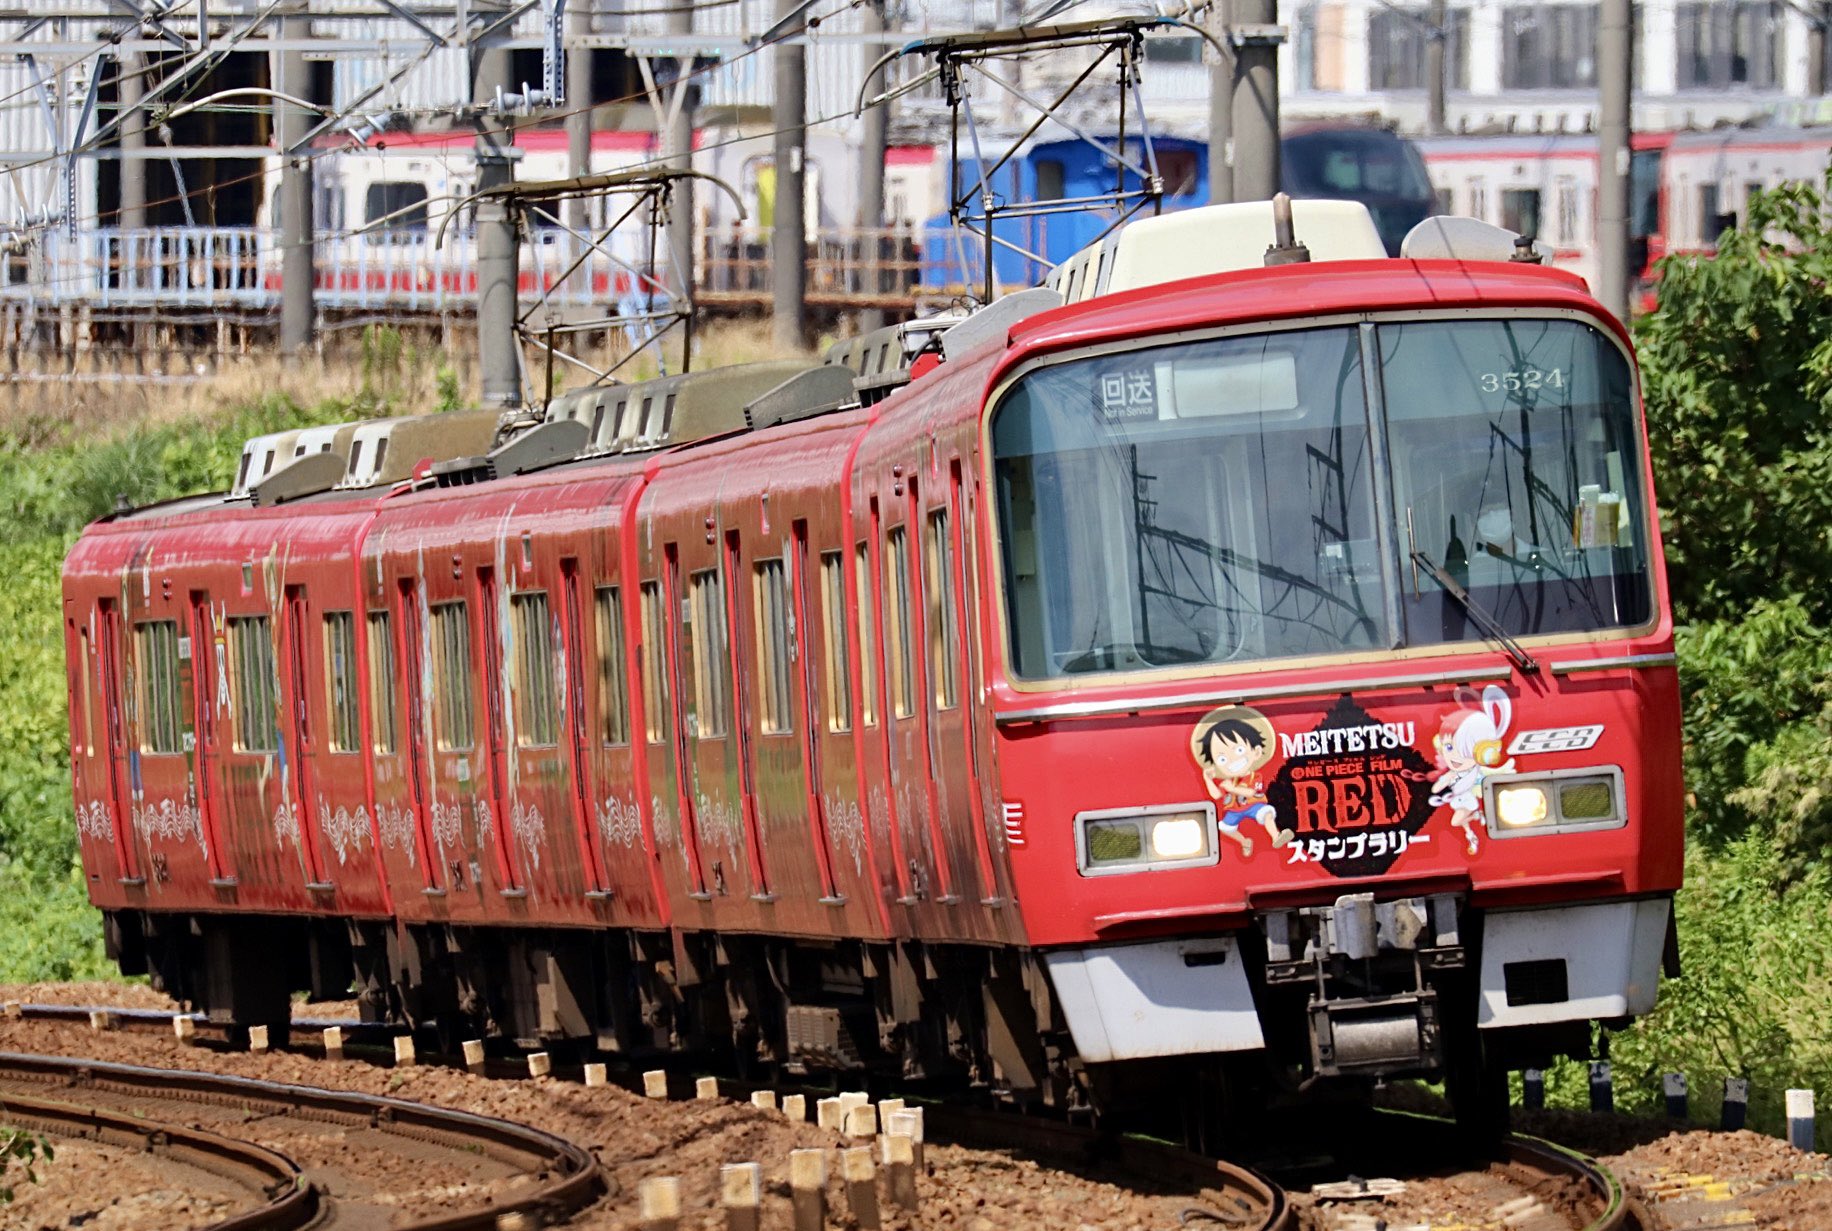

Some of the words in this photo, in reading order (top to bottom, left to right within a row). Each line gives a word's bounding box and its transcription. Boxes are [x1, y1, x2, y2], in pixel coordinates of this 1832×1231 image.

[1101, 371, 1153, 407] 回送
[1480, 368, 1565, 393] 3524
[1126, 406, 1153, 417] Service
[1278, 721, 1415, 758] MEITETSU
[1291, 765, 1324, 779] ONE
[1326, 762, 1364, 777] PIECE
[1370, 759, 1403, 772] FILM
[1291, 773, 1413, 833] RED
[1287, 830, 1431, 865] スタンプラリー
